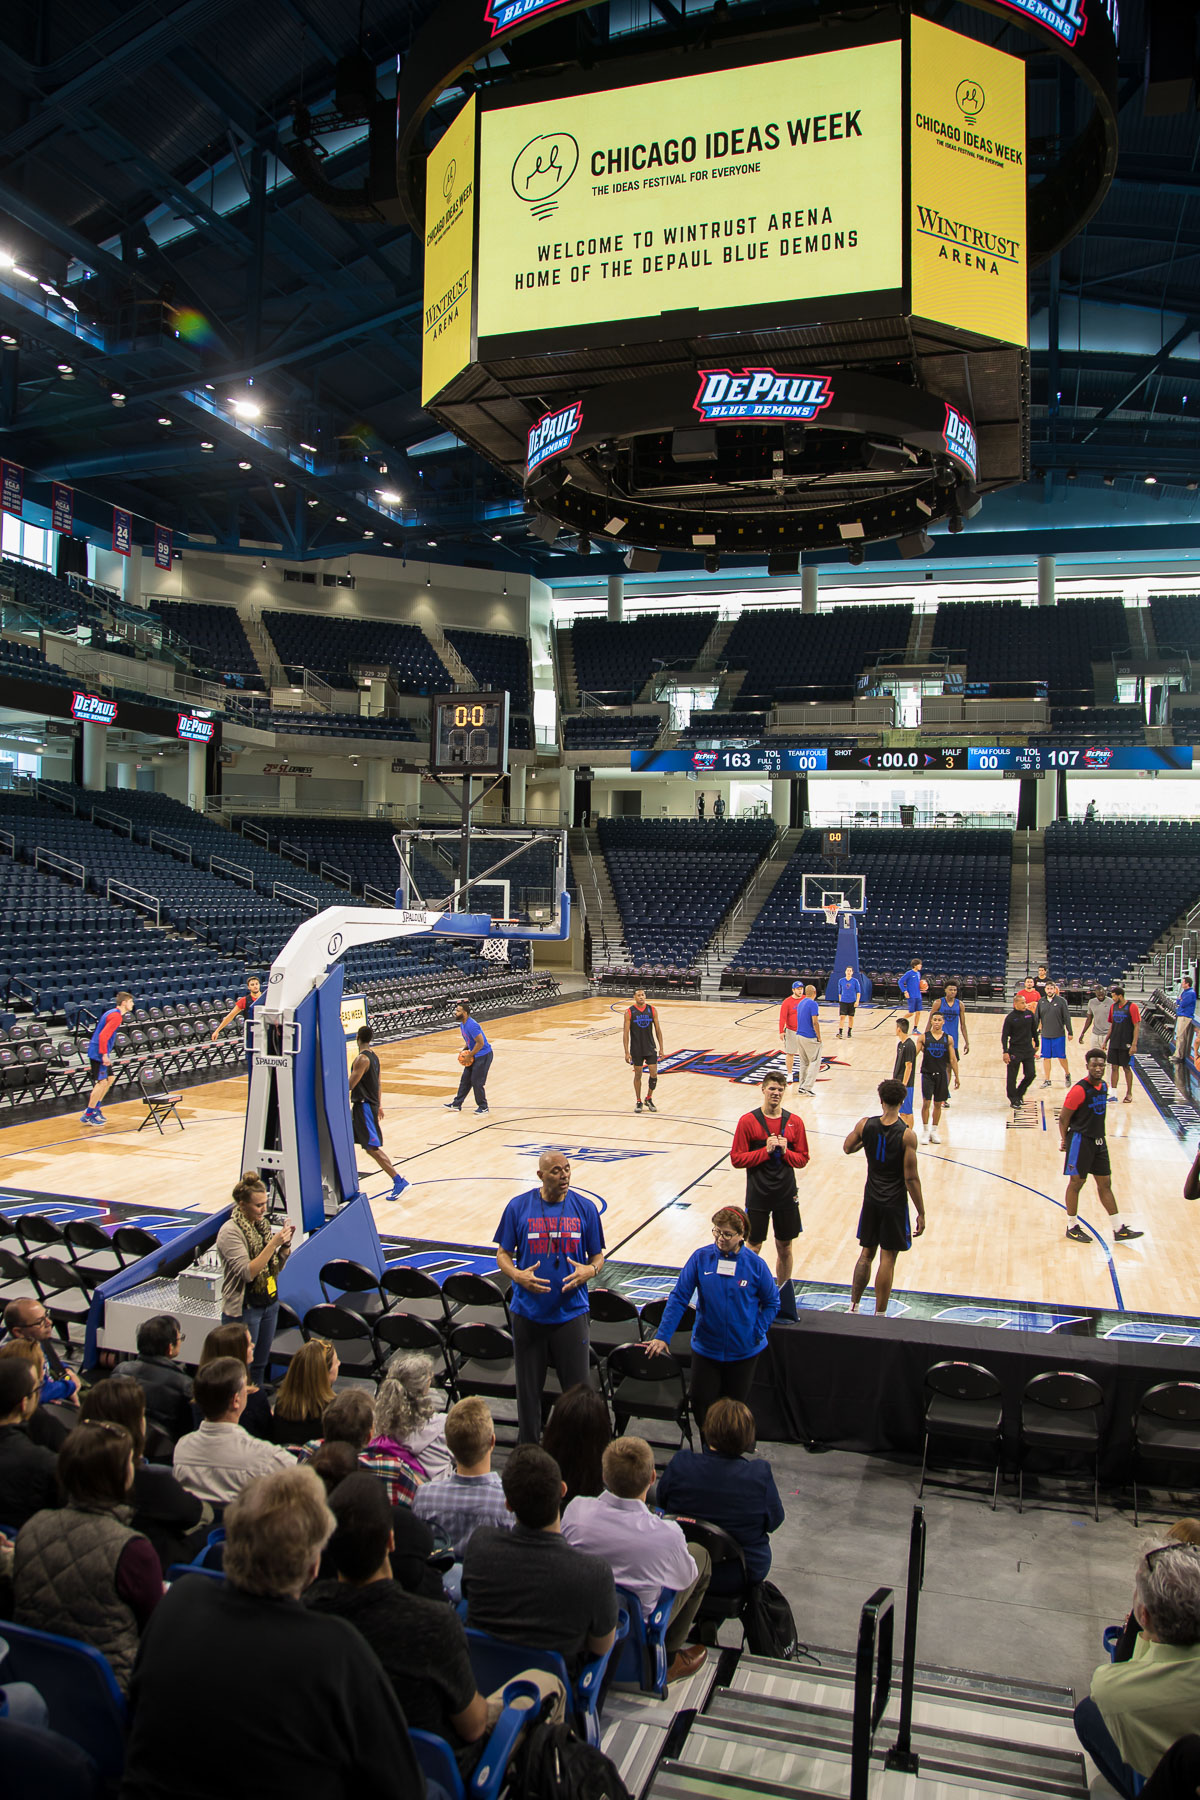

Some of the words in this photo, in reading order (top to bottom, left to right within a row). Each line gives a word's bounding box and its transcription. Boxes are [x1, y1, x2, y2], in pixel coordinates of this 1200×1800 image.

[590, 135, 697, 177] CHICAGO
[705, 122, 781, 160] IDEAS
[786, 109, 863, 147] WEEK
[916, 113, 961, 143] CHICAGO
[963, 130, 993, 154] IDEAS
[995, 142, 1023, 166] WEEK
[592, 184, 610, 197] THE
[612, 180, 640, 194] IDEAS
[643, 173, 687, 189] FESTIVAL
[690, 169, 709, 182] FOR
[711, 162, 761, 179] EVERYONE
[426, 216, 445, 247] CHICAGO
[445, 200, 459, 224] IDEAS
[459, 181, 473, 208] WEEK
[537, 234, 624, 262] WELCOME
[633, 231, 653, 249] TO
[663, 216, 758, 245] WINTRUST
[767, 206, 833, 232] ARENA
[916, 204, 1020, 258] WINTRUST
[515, 268, 561, 290] HOME
[570, 264, 591, 283] OF
[601, 259, 633, 279] THE
[642, 249, 713, 274] DEPAUL
[723, 241, 770, 263] BLUE
[779, 230, 859, 257] DEMONS
[938, 245, 999, 275] ARENA
[425, 270, 469, 328] WINTRUST
[433, 306, 459, 341] ARENA
[710, 405, 747, 416] BLUE
[753, 405, 811, 416] DEMONS
[117, 526, 128, 539] 24
[158, 542, 169, 554] 99
[877, 752, 918, 767] :00.0
[942, 748, 962, 756] HALF
[1047, 750, 1079, 766] 107
[722, 753, 751, 767] 163
[799, 756, 817, 769] 00
[945, 756, 954, 769] 3
[979, 755, 998, 769] 00
[402, 910, 427, 923] SPALDING
[340, 1010, 351, 1022] EAS
[255, 1057, 288, 1067] SPALDING
[528, 1217, 558, 1232] THROW
[559, 1217, 581, 1232] FIRST
[561, 1239, 580, 1254] LAST
